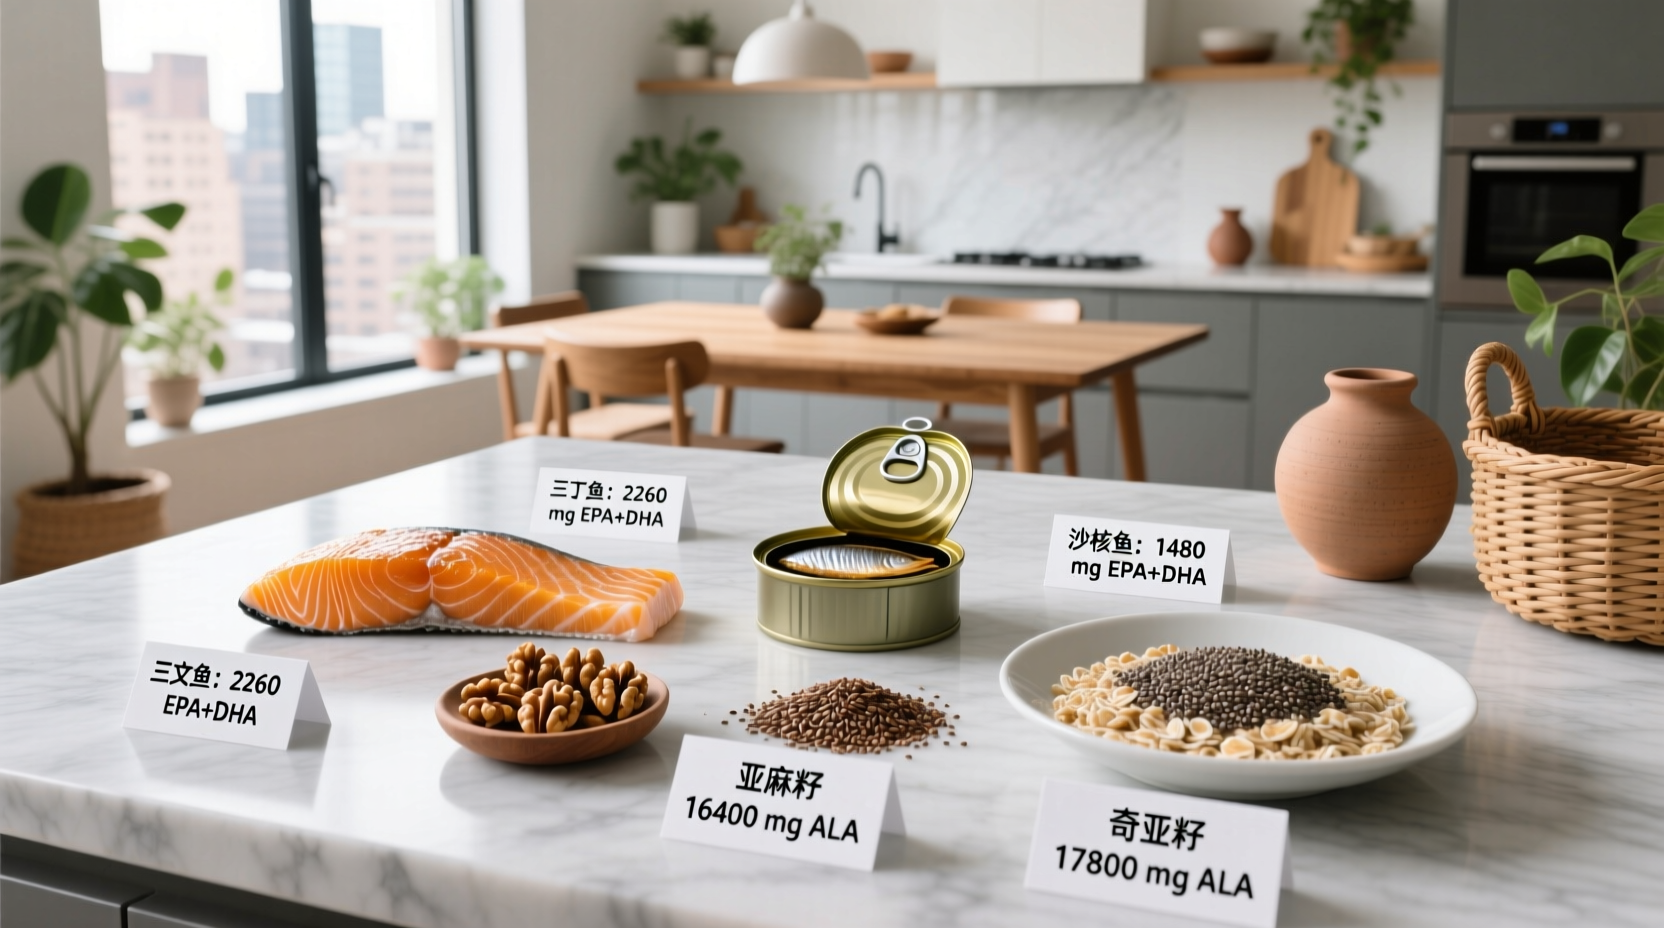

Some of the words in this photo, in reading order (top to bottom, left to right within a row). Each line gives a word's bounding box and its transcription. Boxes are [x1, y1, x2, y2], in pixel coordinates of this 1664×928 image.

[622, 484, 668, 504] 2260
[548, 507, 576, 527] mg
[580, 506, 664, 528] EPA+DHA
[1156, 537, 1206, 560] 1480
[1071, 560, 1102, 582] mg
[1107, 560, 1207, 586] EPA+DHA
[229, 670, 282, 696] 2260
[162, 694, 257, 726] EPA+DHA
[735, 761, 824, 801] 亚麻籽
[686, 795, 759, 828] 16400
[764, 813, 803, 842] mg
[808, 814, 859, 844] ALA
[1109, 807, 1206, 852] 奇亚籽
[1056, 844, 1138, 881] 17800
[1145, 865, 1189, 897] mg
[1196, 867, 1254, 899] ALA
